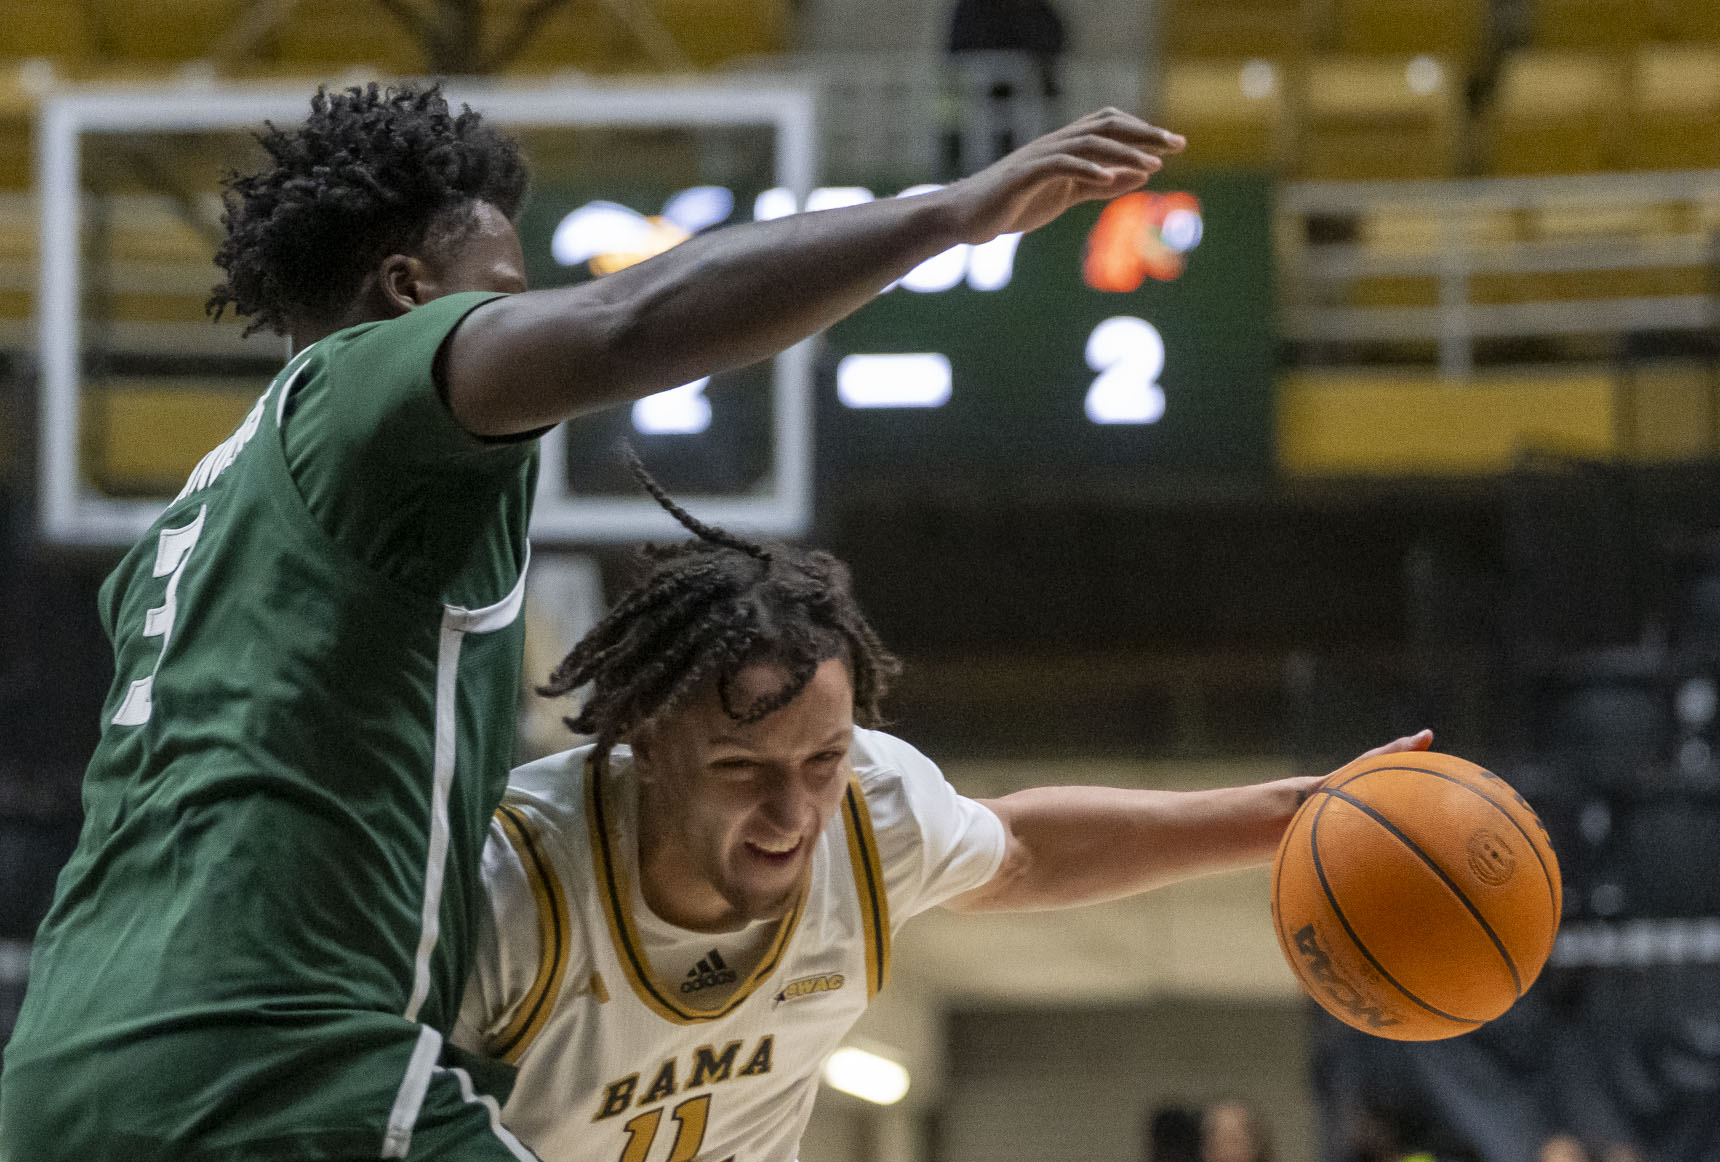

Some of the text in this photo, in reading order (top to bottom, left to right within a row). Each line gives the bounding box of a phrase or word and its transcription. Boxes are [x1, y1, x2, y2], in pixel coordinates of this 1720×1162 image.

[1085, 314, 1167, 426] 2
[784, 974, 846, 998] SWAC
[591, 1034, 775, 1123] BAMA
